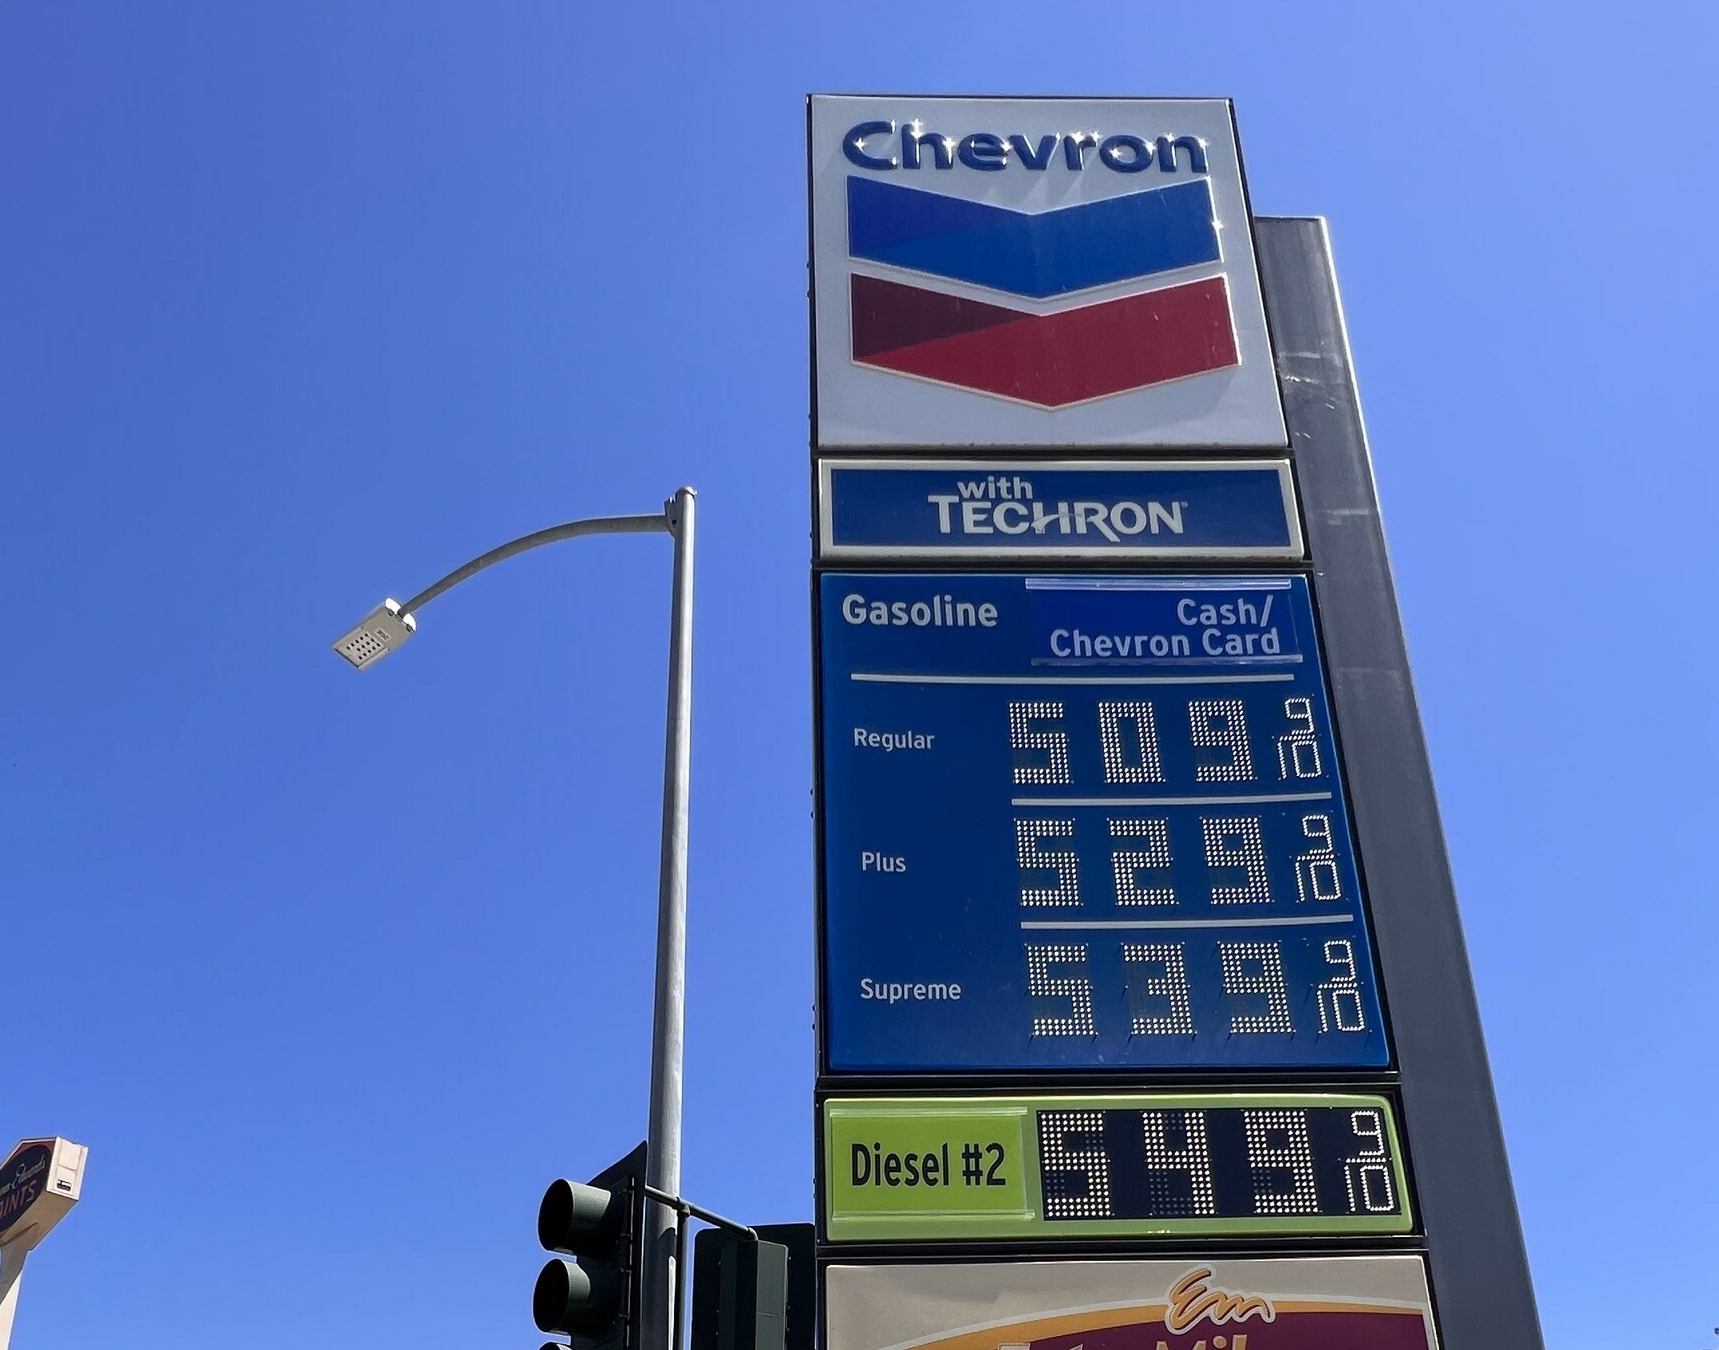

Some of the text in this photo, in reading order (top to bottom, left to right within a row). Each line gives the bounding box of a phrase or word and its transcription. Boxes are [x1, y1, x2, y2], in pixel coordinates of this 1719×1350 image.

[842, 119, 1208, 173] Chevron
[958, 477, 1033, 500] with
[928, 495, 1184, 541] TECHRON
[842, 594, 998, 626] Gasoline
[1177, 595, 1273, 627] Cash/
[1050, 629, 1280, 657] Chevron Card
[853, 728, 935, 750] Regular
[1008, 699, 1253, 783] 509
[861, 851, 907, 873] Plus
[1015, 817, 1271, 906] 529
[860, 979, 961, 1003] Supreme
[1027, 941, 1291, 1036] 539
[851, 1142, 1006, 1187] Diesel #2
[1041, 1110, 1319, 1218] 549
